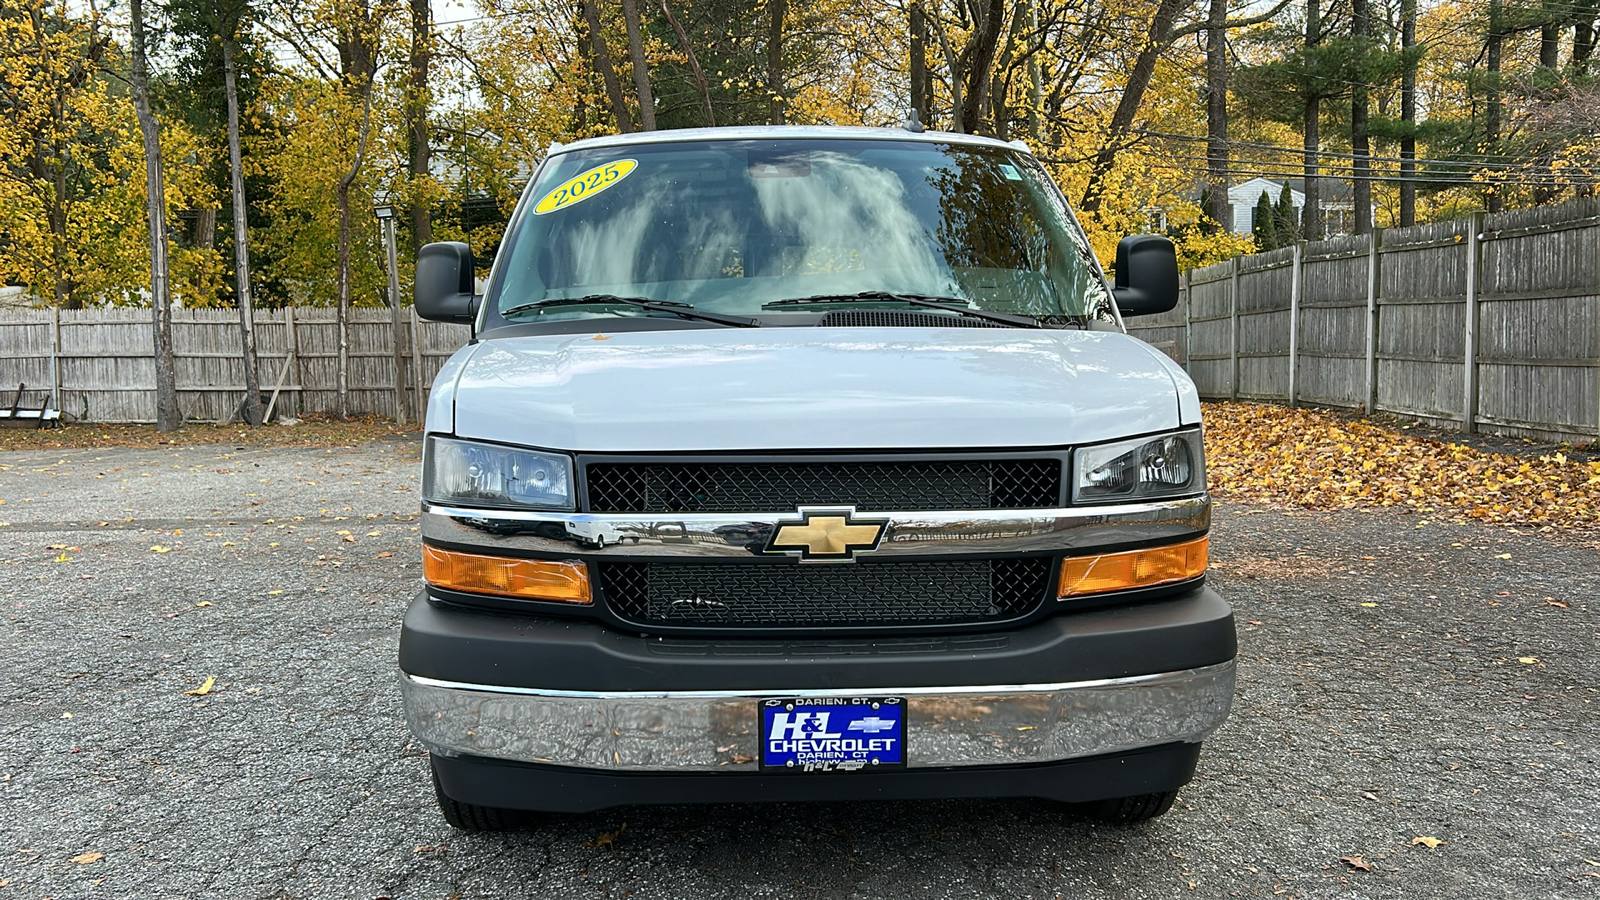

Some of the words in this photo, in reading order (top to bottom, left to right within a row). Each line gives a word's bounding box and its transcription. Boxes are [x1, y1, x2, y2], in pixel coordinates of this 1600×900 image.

[554, 164, 619, 207] 2025
[795, 698, 847, 706] DARIEN,
[851, 697, 871, 705] CT.
[769, 712, 842, 740] H&L
[770, 738, 896, 752] CHEVROLET
